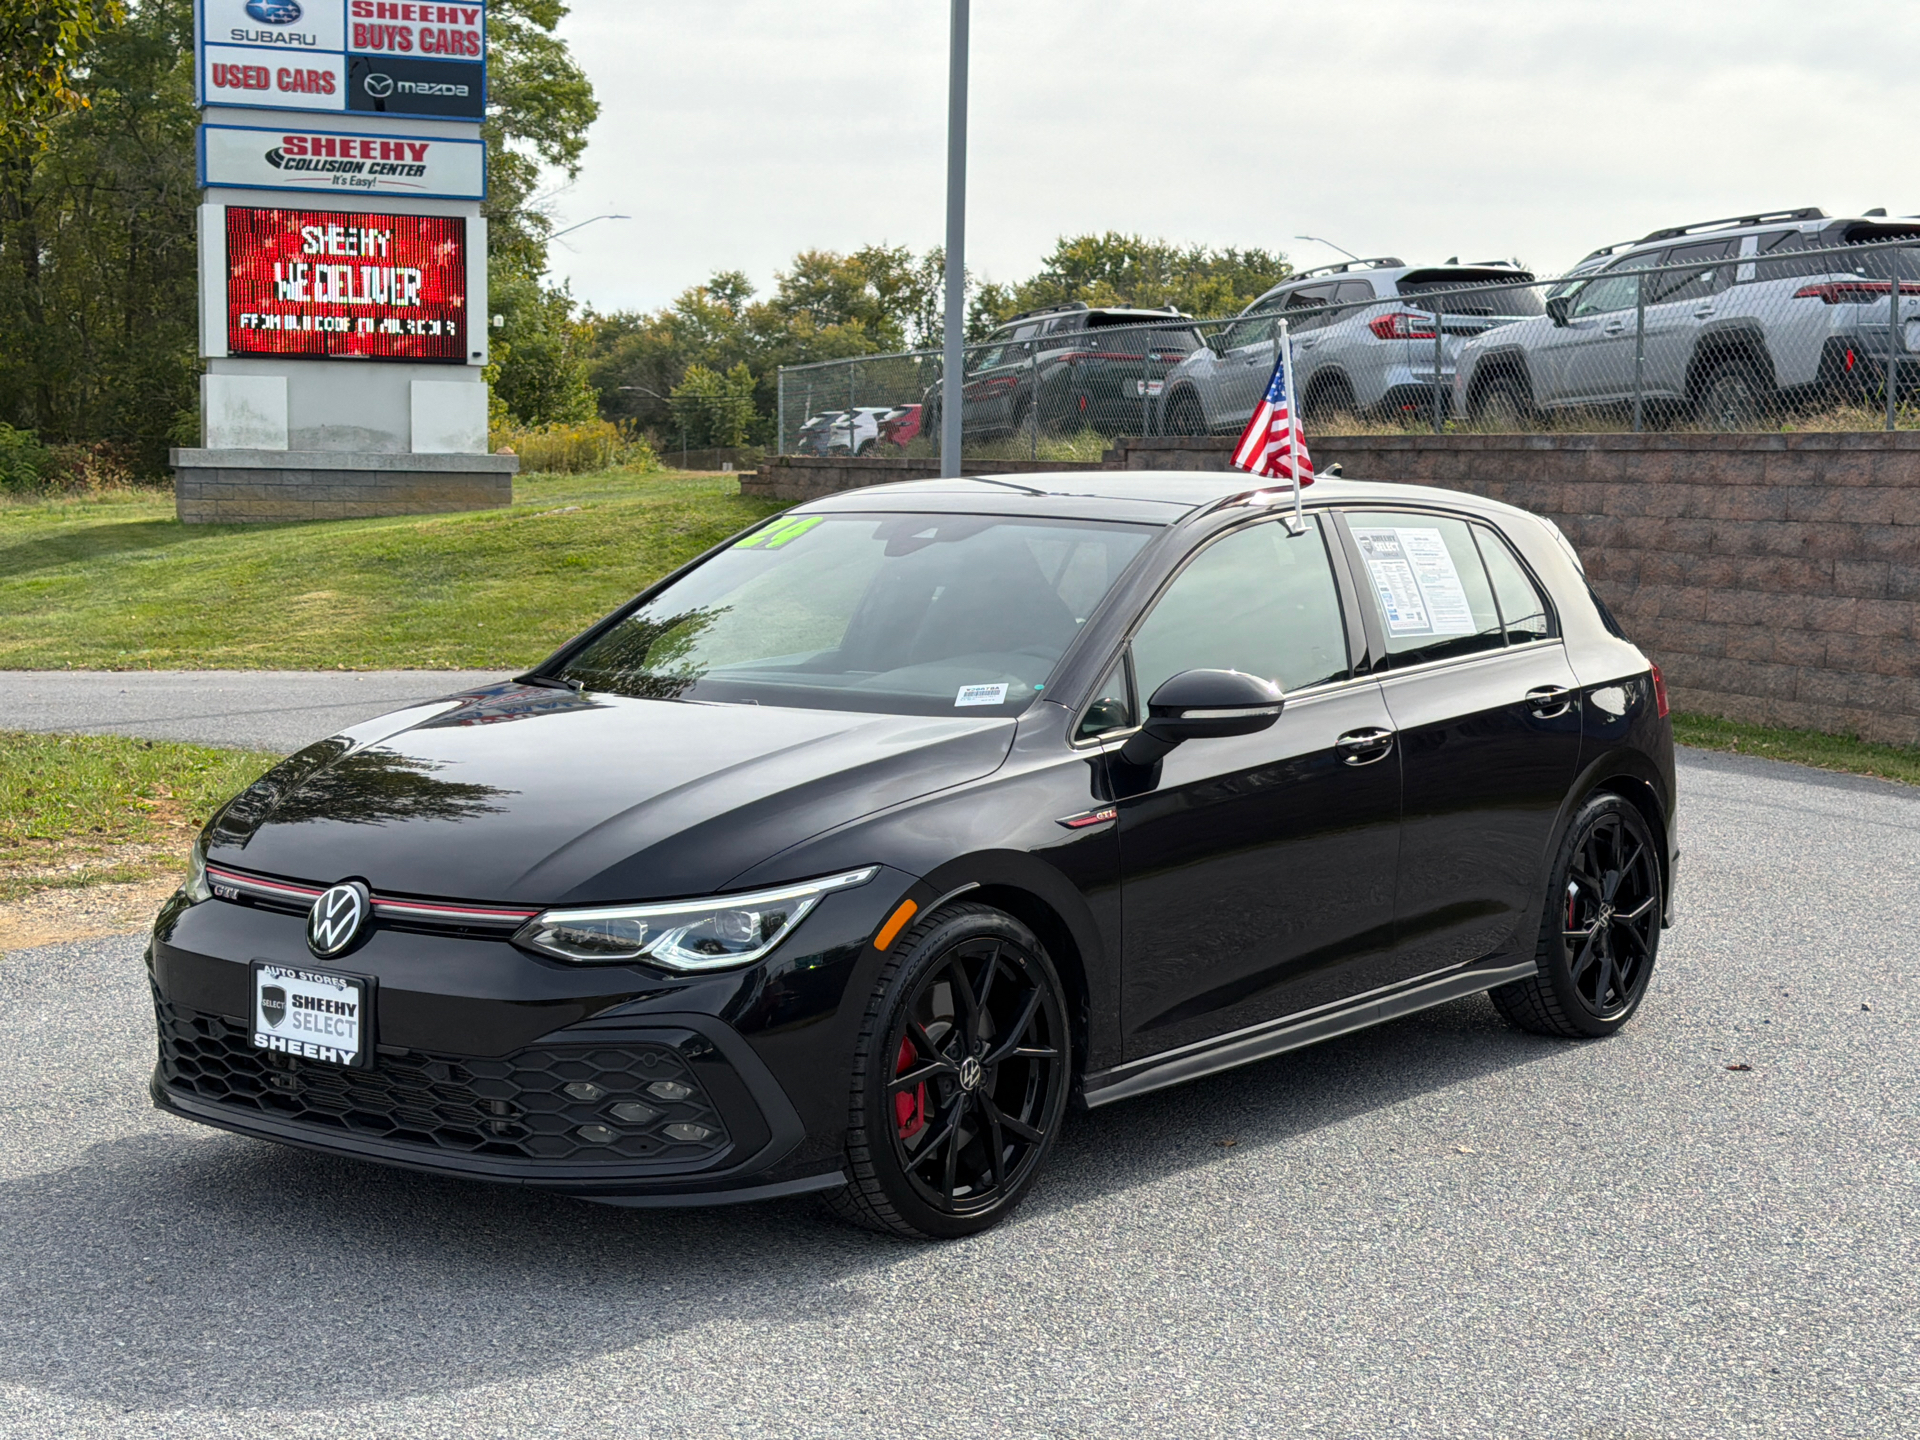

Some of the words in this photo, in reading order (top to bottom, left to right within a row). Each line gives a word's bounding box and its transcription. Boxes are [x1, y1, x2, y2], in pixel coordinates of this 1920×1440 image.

[352, 1, 480, 26] SHEEHY
[230, 28, 316, 46] SUBARU
[353, 22, 413, 52] BUYS
[419, 27, 480, 56] CARS
[212, 62, 270, 90] USED
[277, 67, 336, 95] CARS
[282, 135, 430, 163] SHEEHY
[283, 157, 364, 175] COLLISION
[368, 162, 427, 178] CENTER
[331, 174, 350, 188] It's
[353, 175, 376, 190] Easy!
[1096, 810, 1114, 820] GTI
[213, 884, 240, 900] GTI
[263, 965, 296, 978] AUTO
[298, 971, 348, 988] STORES
[262, 998, 285, 1010] SELECT
[291, 993, 357, 1018] SHEEHY
[292, 1011, 357, 1039] SELECT
[253, 1033, 356, 1066] SHEEHY
